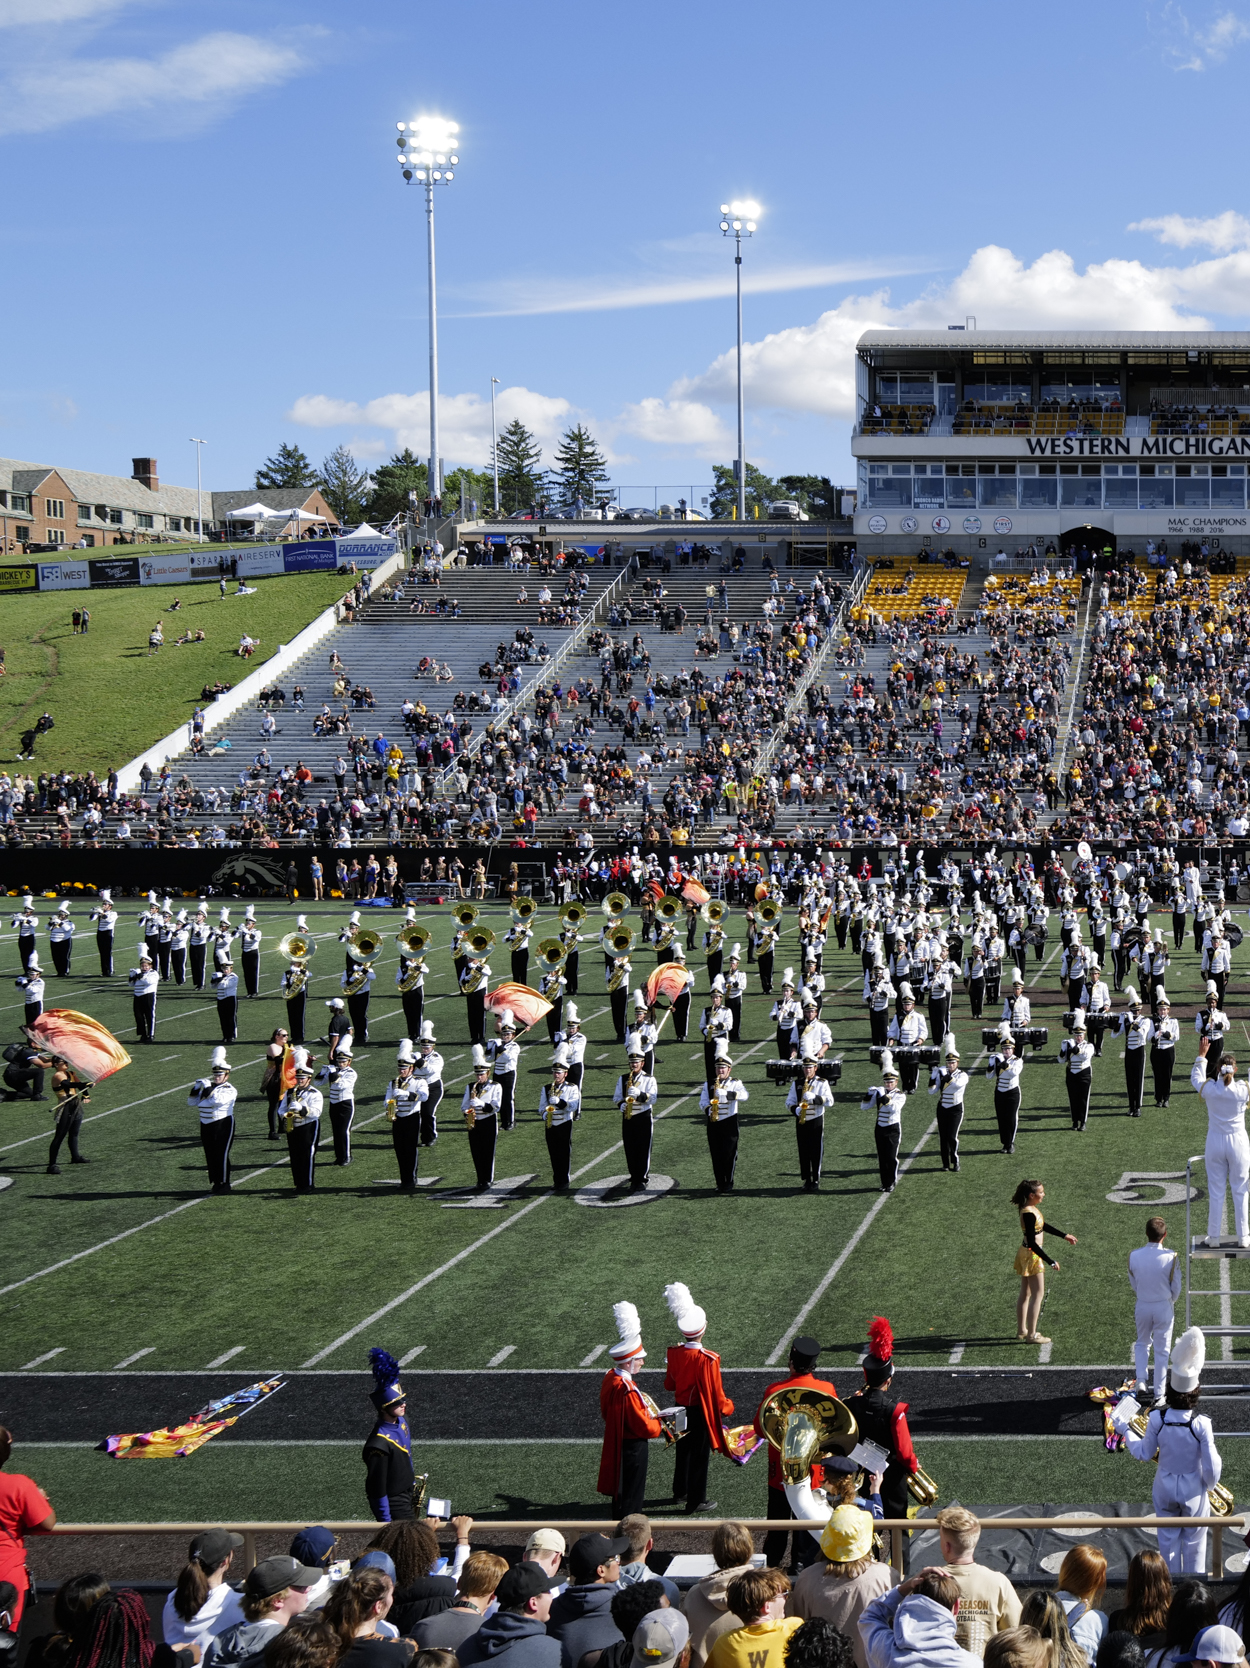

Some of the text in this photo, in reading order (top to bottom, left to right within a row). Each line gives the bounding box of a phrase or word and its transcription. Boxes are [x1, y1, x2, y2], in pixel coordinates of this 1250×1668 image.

[1026, 437, 1130, 455] WESTERN
[1168, 518, 1247, 526] MAC CHAMPIONS
[980, 539, 986, 548] C
[63, 570, 87, 580] WEST
[959, 1600, 989, 1610] SEASON
[748, 1649, 769, 1668] W
